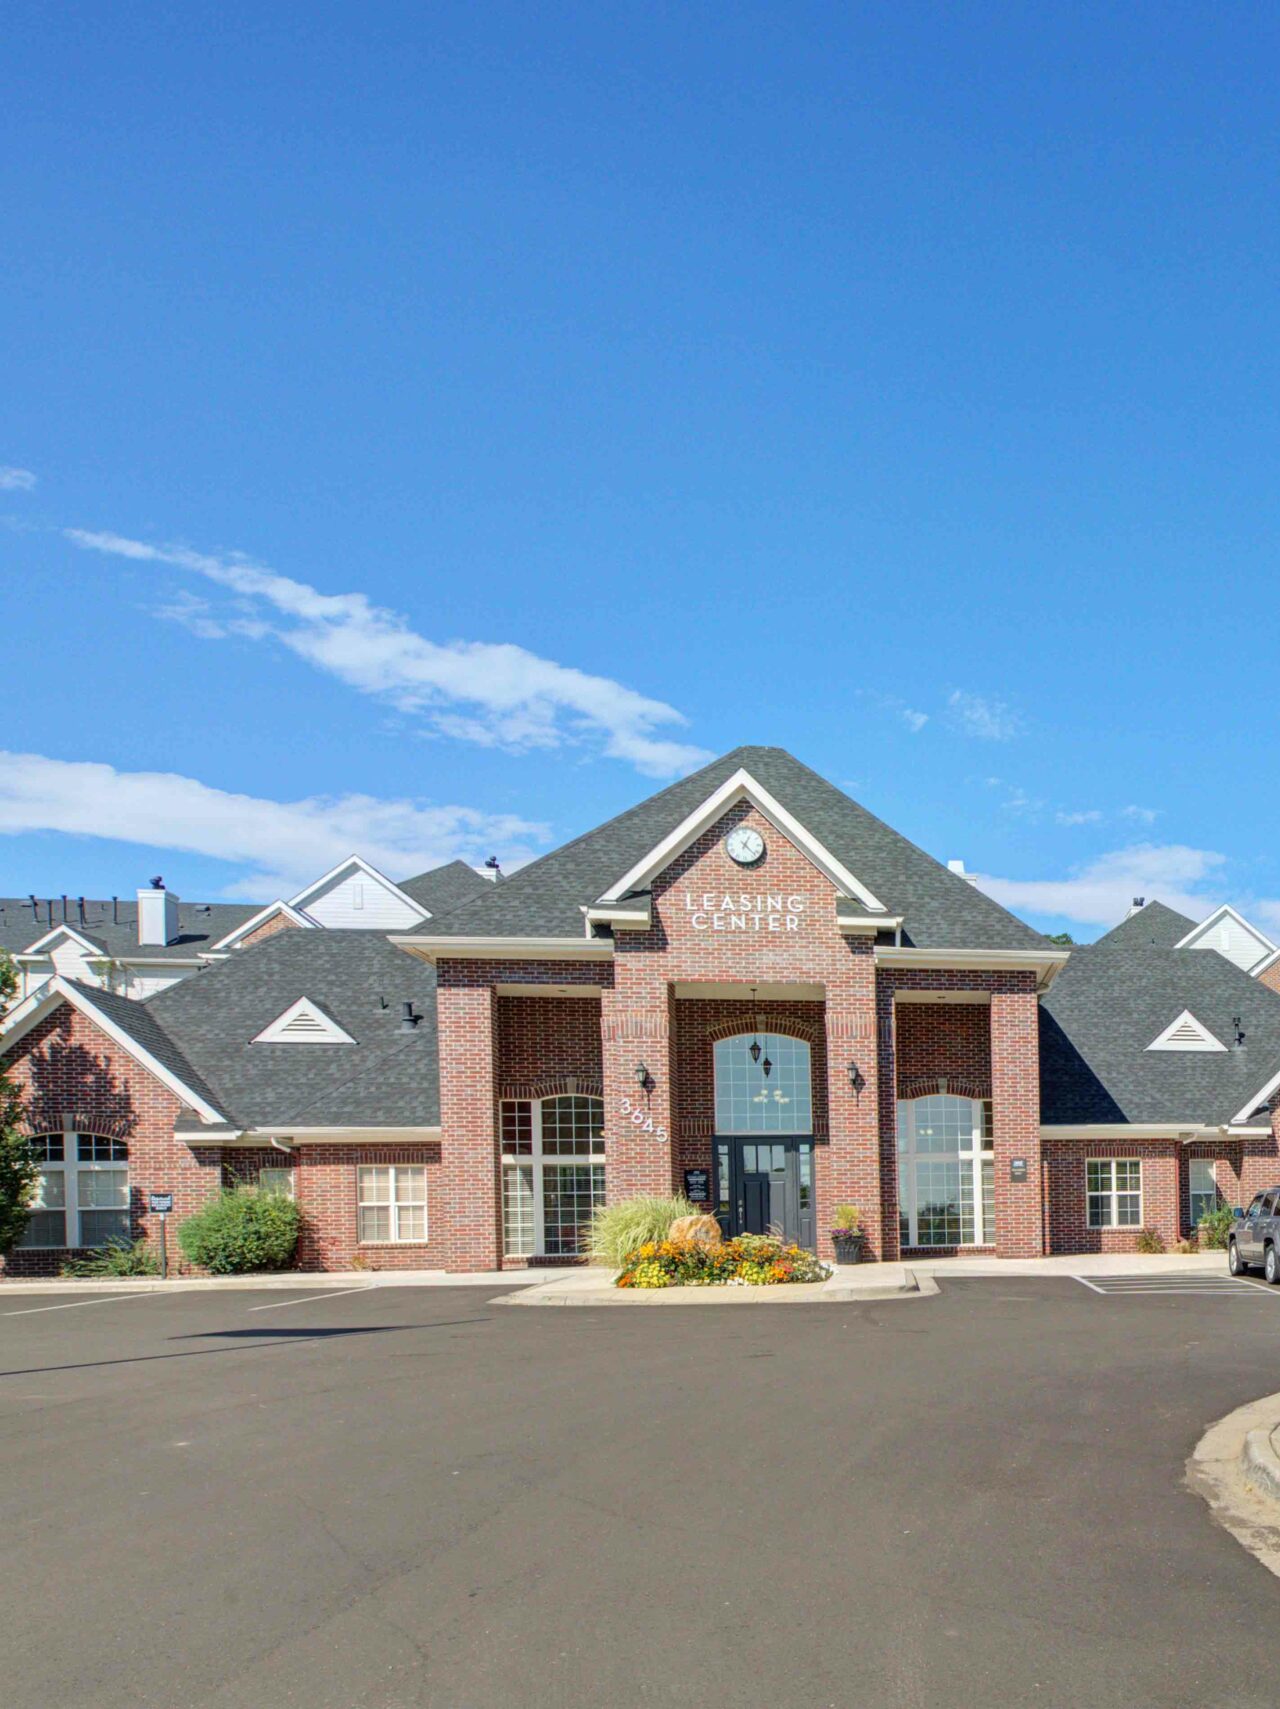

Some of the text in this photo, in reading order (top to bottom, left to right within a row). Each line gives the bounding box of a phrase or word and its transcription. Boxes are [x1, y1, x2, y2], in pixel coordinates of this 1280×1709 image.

[686, 893, 804, 912] LEASING
[692, 913, 799, 931] CENTER
[620, 1099, 668, 1142] 3645
